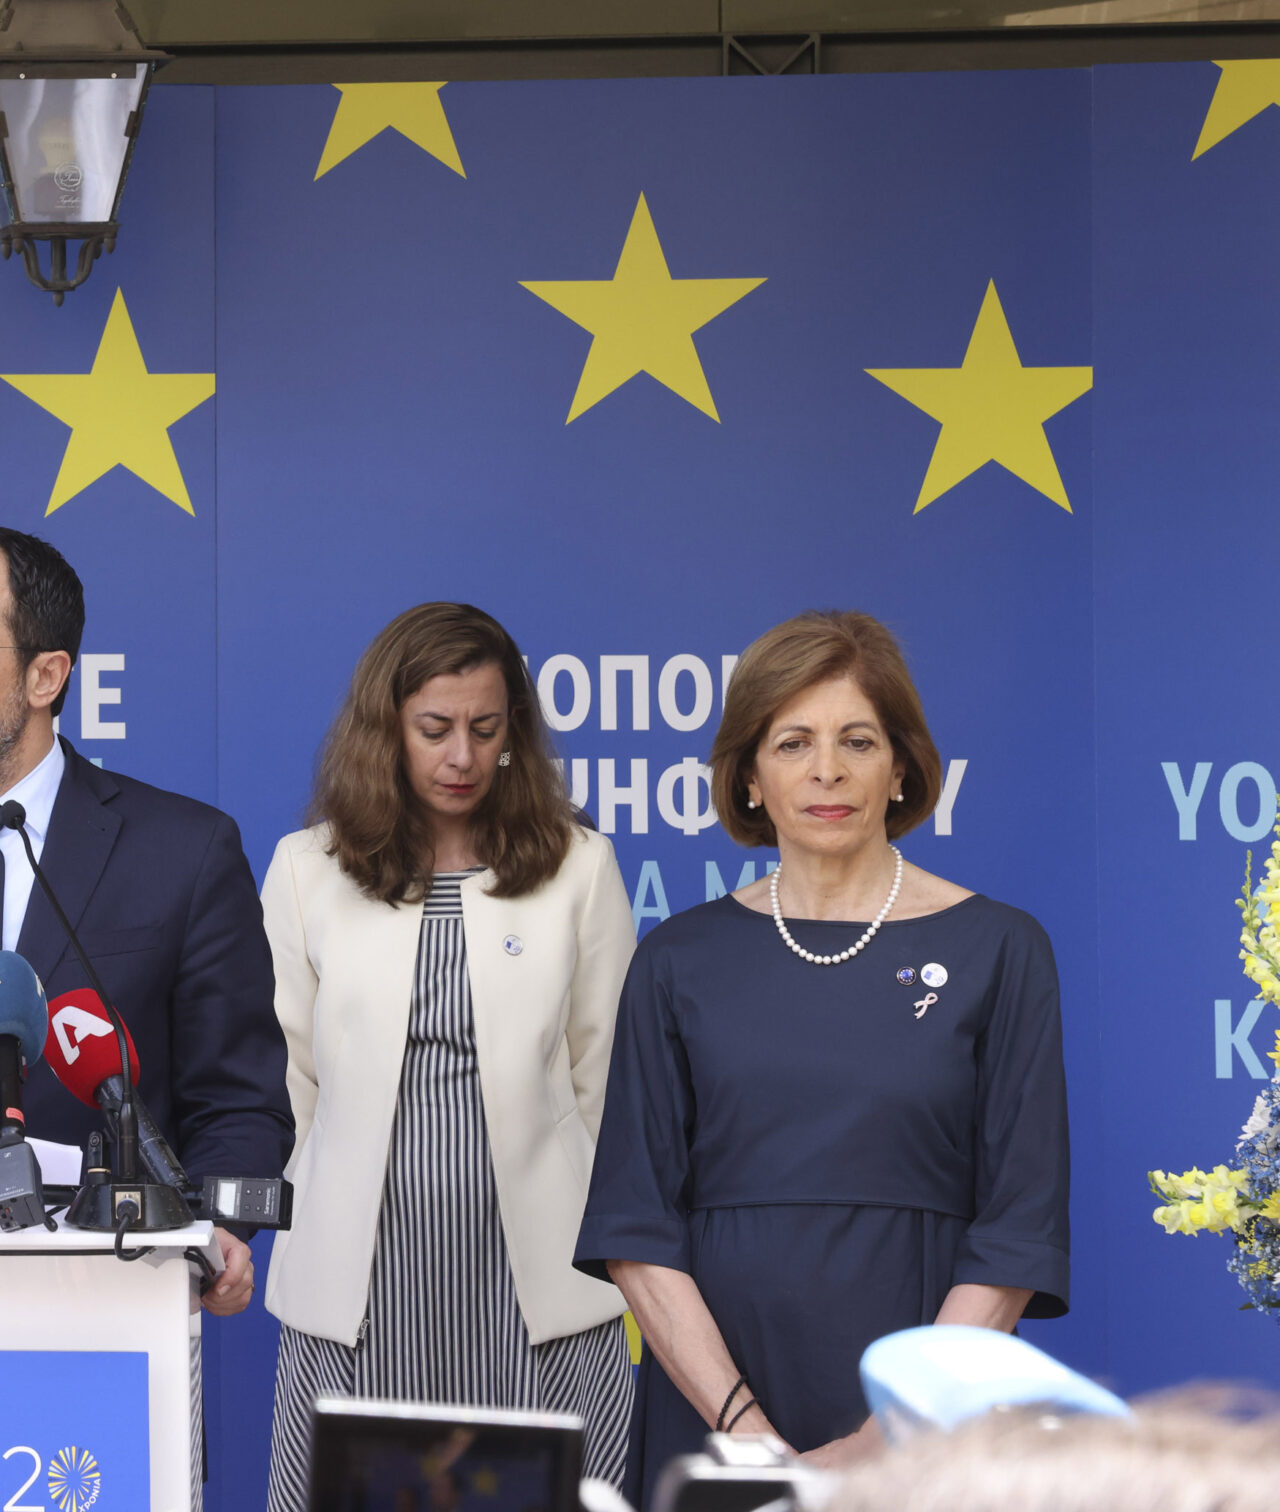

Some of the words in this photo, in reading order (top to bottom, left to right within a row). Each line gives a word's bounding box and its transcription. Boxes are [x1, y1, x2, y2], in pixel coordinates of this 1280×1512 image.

[521, 653, 739, 732] ΟΠΟ
[934, 759, 969, 836] Υ
[1160, 761, 1278, 843] YO
[1214, 999, 1270, 1079] K
